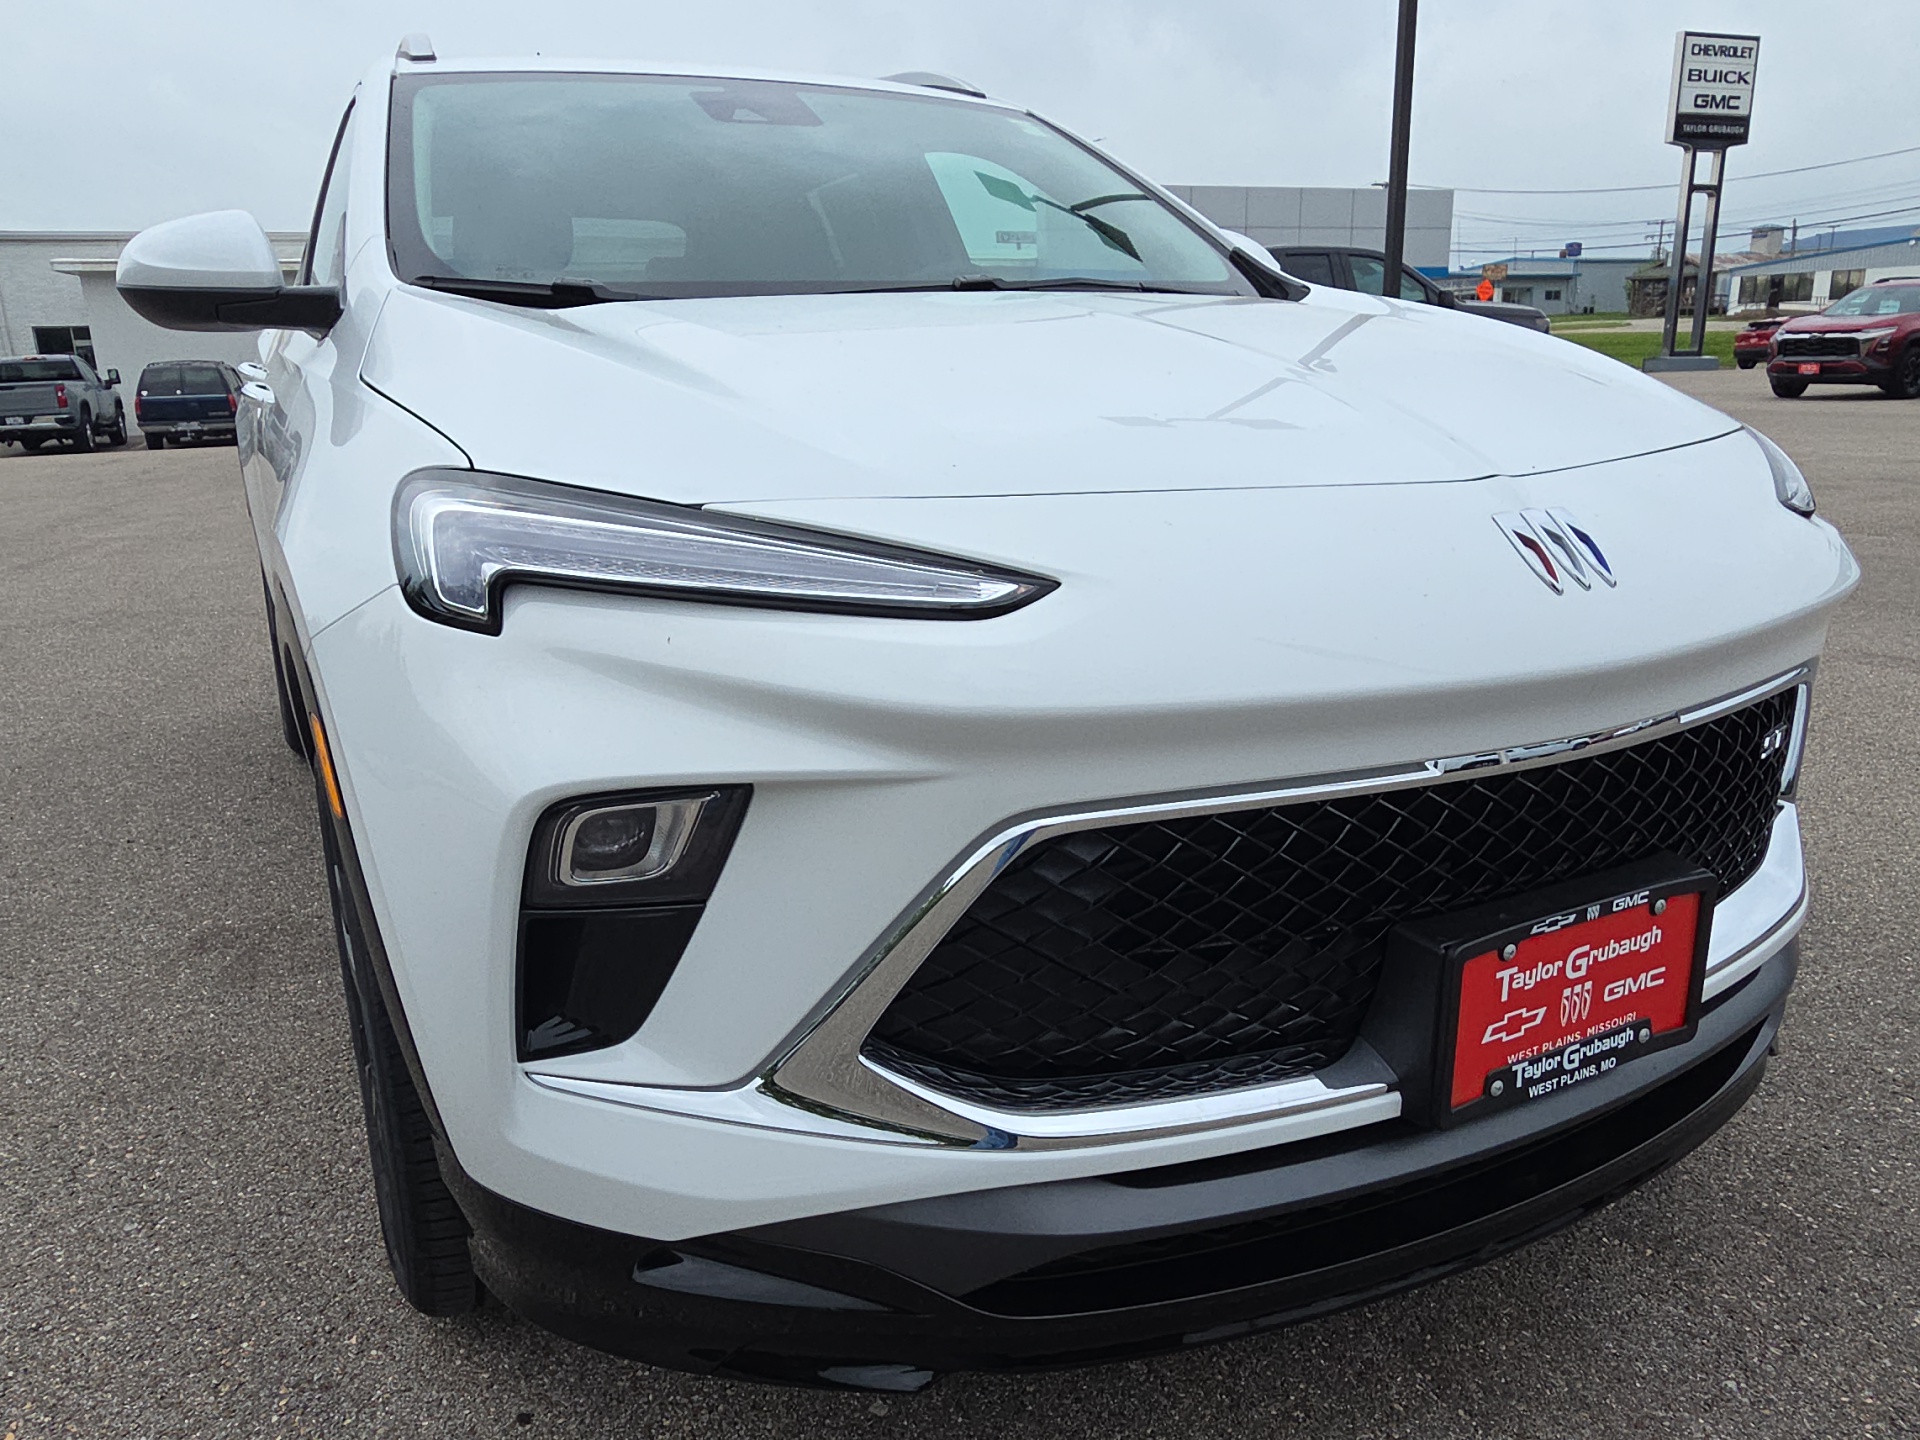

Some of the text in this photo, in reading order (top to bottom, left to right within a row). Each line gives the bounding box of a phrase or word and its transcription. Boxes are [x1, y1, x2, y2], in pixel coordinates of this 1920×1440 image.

[1691, 43, 1754, 59] CHEVROLET
[1687, 68, 1750, 85] BUICK
[1693, 94, 1741, 110] GMC
[1612, 891, 1650, 912] GMC
[1496, 925, 1662, 1003] Taylor Grubaugh
[1603, 966, 1666, 1002] GMC
[1507, 1046, 1539, 1064] WEST
[1587, 1011, 1637, 1037] MISSOURI
[1512, 1027, 1634, 1088] Taylor Grubaugh
[1528, 1057, 1617, 1099] WEST PLAINS, MO
